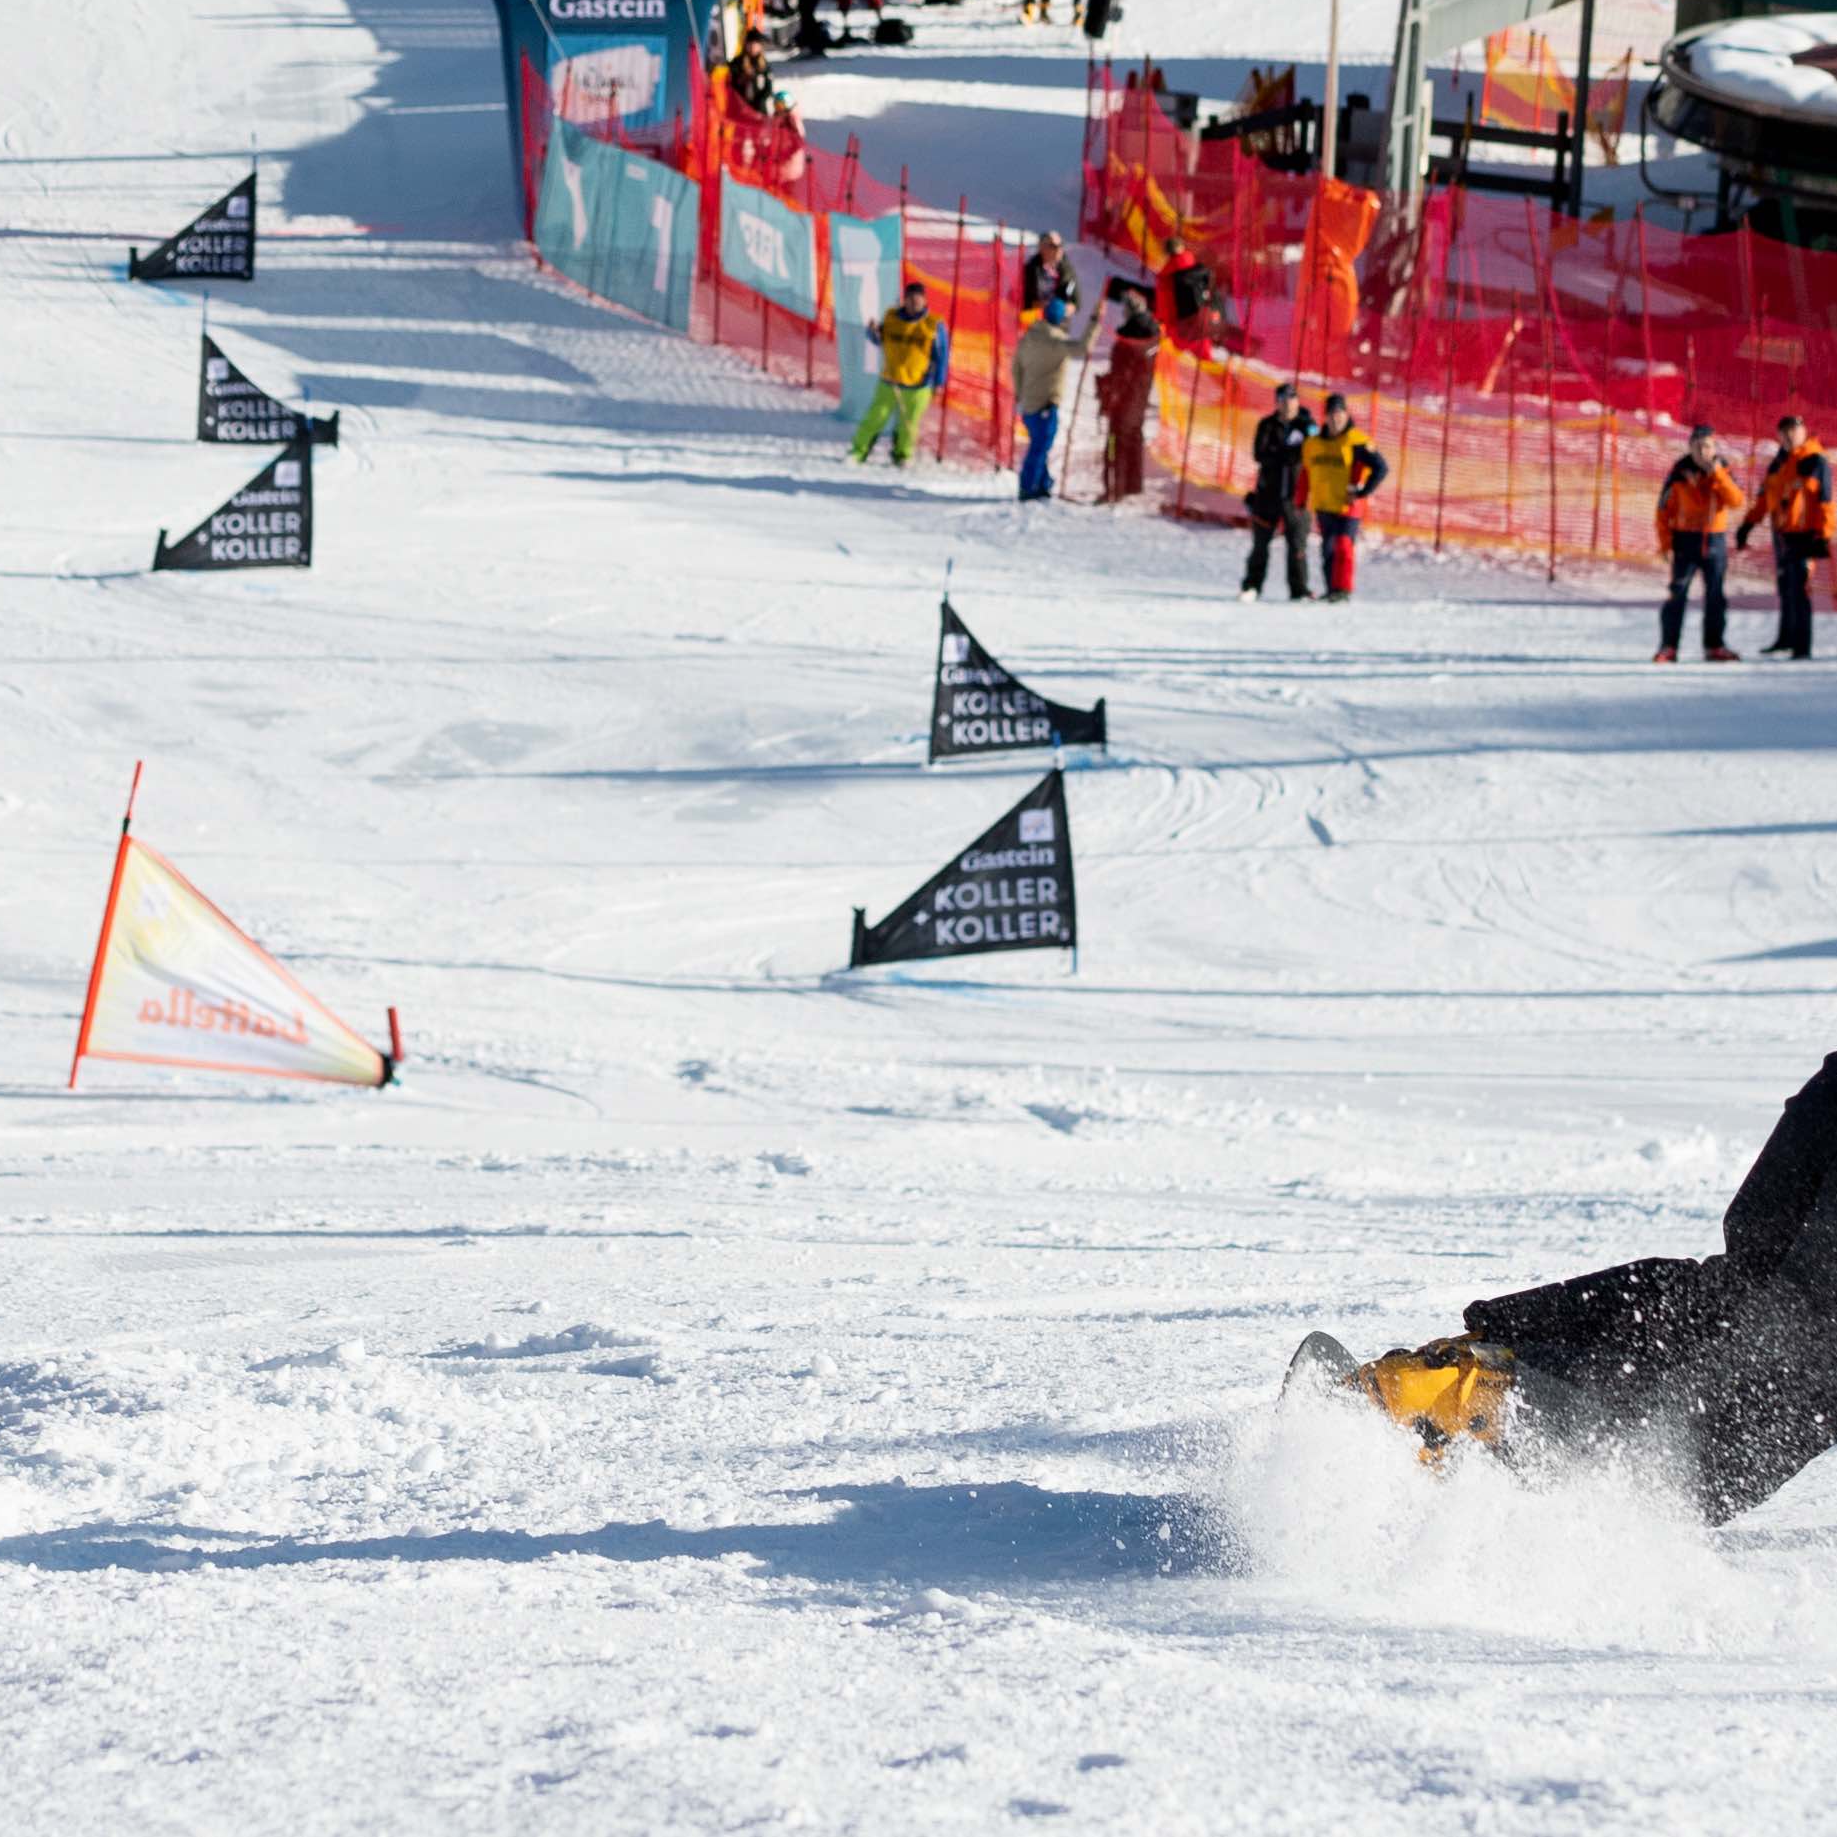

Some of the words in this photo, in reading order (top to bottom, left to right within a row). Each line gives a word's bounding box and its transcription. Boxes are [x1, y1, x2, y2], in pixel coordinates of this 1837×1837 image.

[175, 235, 249, 255] KOLLER
[175, 254, 248, 274] KOLLER
[216, 421, 298, 442] KOLLER
[210, 512, 302, 535] KOLLER
[210, 537, 302, 561] KOLLER
[952, 690, 1048, 717] KOLLER
[952, 719, 1052, 747] KOLLER
[960, 843, 1056, 873] Gastein
[934, 877, 1059, 914] KOLLER
[935, 909, 1061, 947] KOLLER
